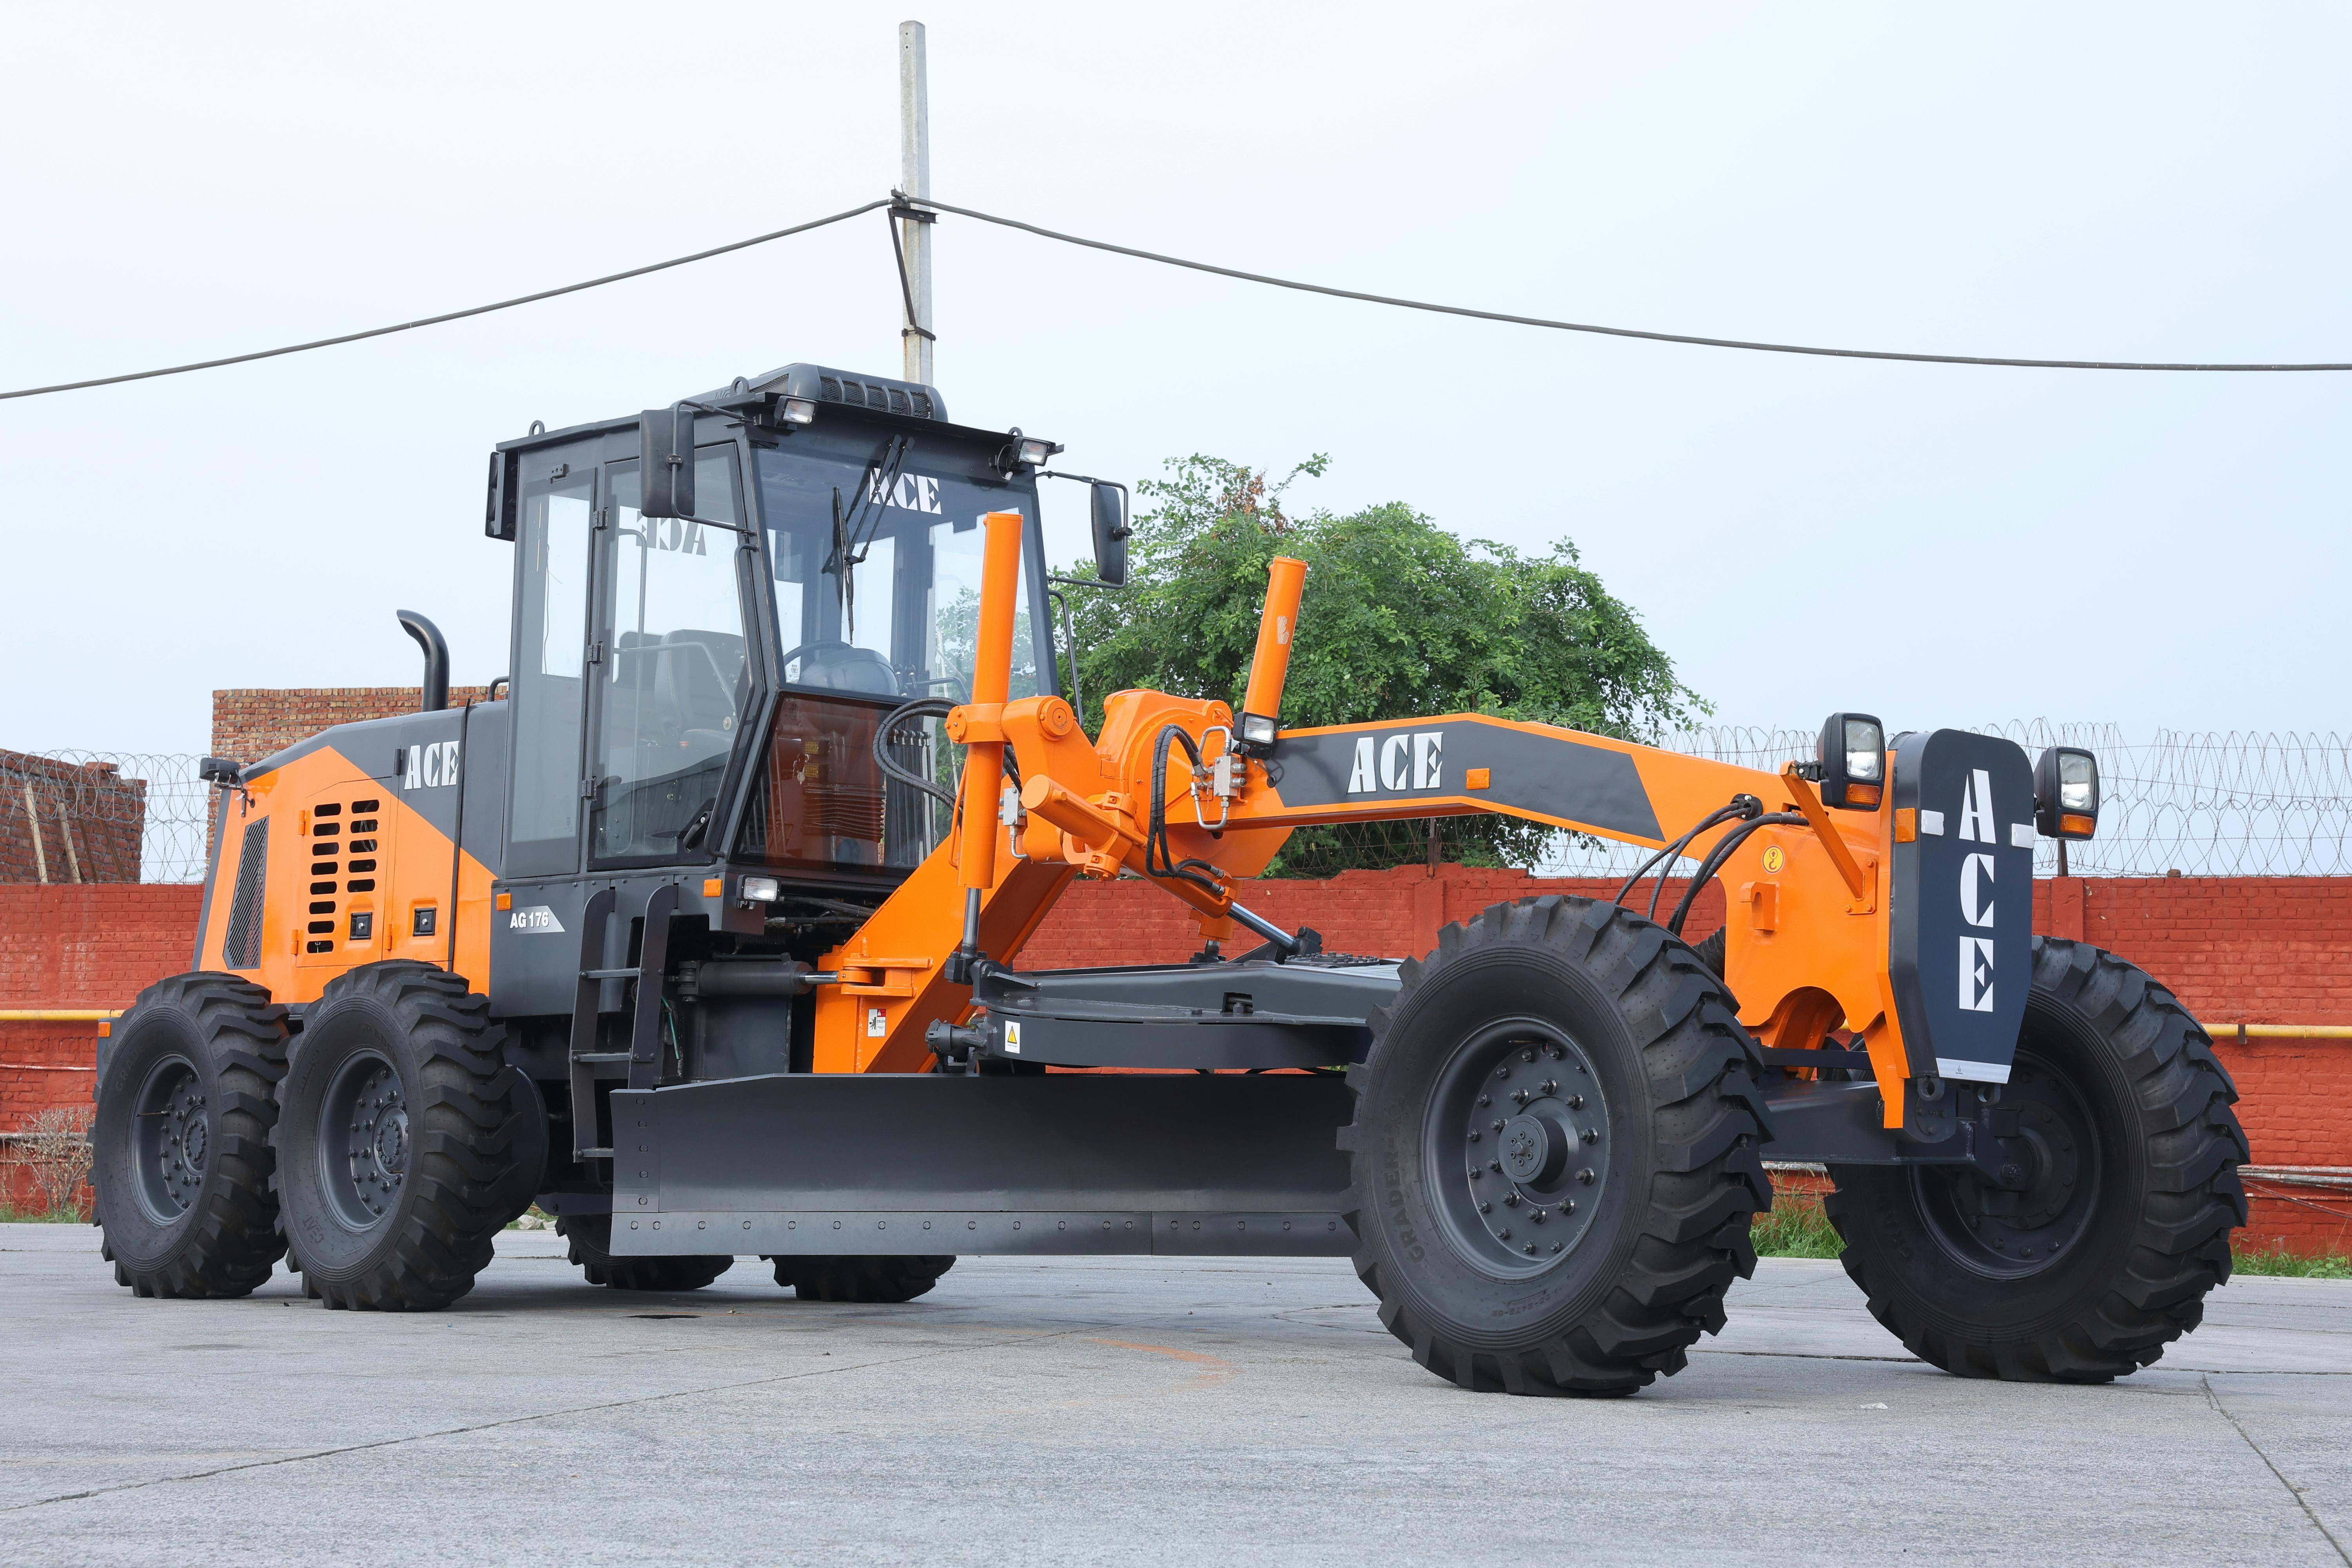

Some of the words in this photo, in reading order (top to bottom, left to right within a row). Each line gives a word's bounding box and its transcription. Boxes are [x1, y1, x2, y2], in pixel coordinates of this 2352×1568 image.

[869, 468, 941, 515] ACE
[404, 740, 460, 790] ACE
[1347, 732, 1443, 793] ACE
[1959, 768, 1996, 1012] ACE
[510, 913, 526, 928] AG
[529, 911, 549, 927] 176
